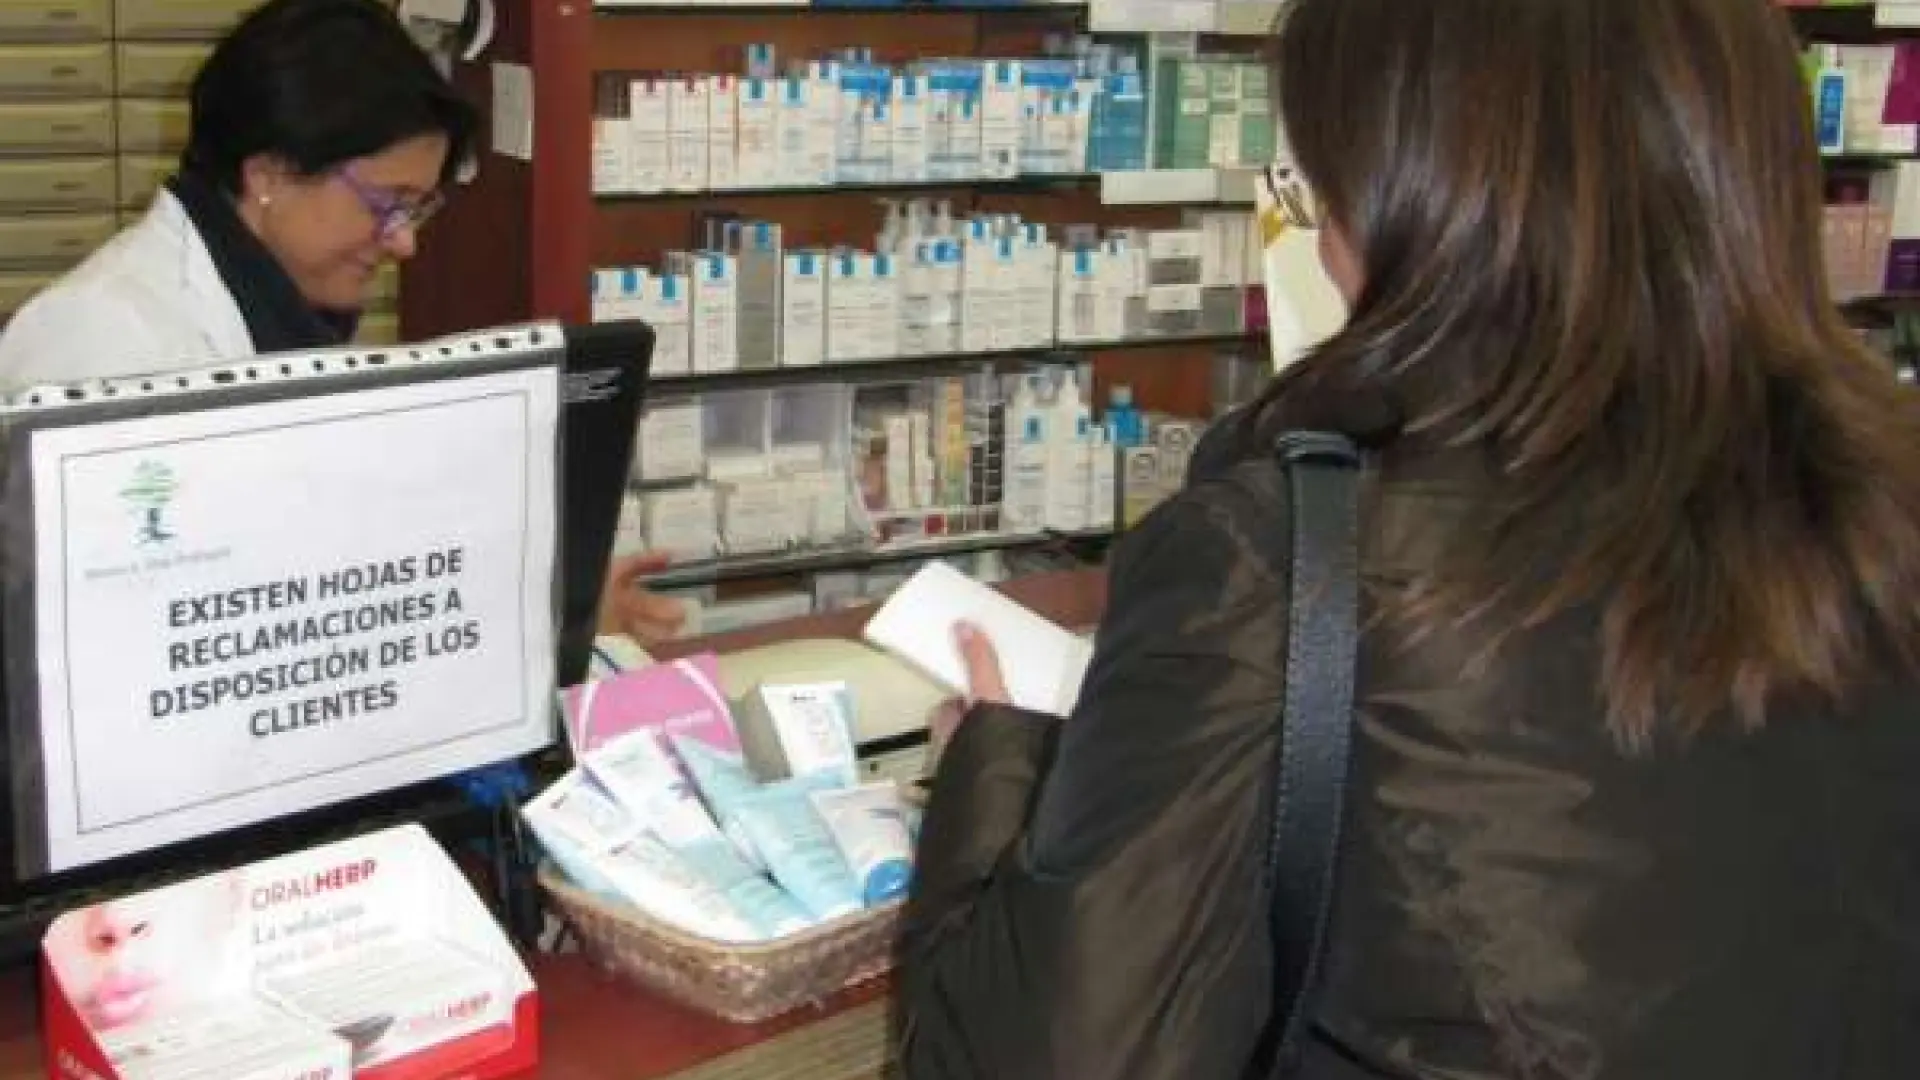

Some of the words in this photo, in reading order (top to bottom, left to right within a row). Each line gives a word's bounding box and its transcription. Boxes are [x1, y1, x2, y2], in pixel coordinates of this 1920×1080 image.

[169, 574, 307, 628] EXISTEN
[319, 555, 417, 600] HOJAS
[426, 546, 463, 578] DE
[150, 643, 369, 719] DISPOSICIÓN
[380, 635, 417, 669] DE
[426, 619, 481, 656] LOS
[169, 593, 436, 672] RECLAMACIONES
[445, 587, 462, 614] A
[251, 680, 399, 737] CLIENTES
